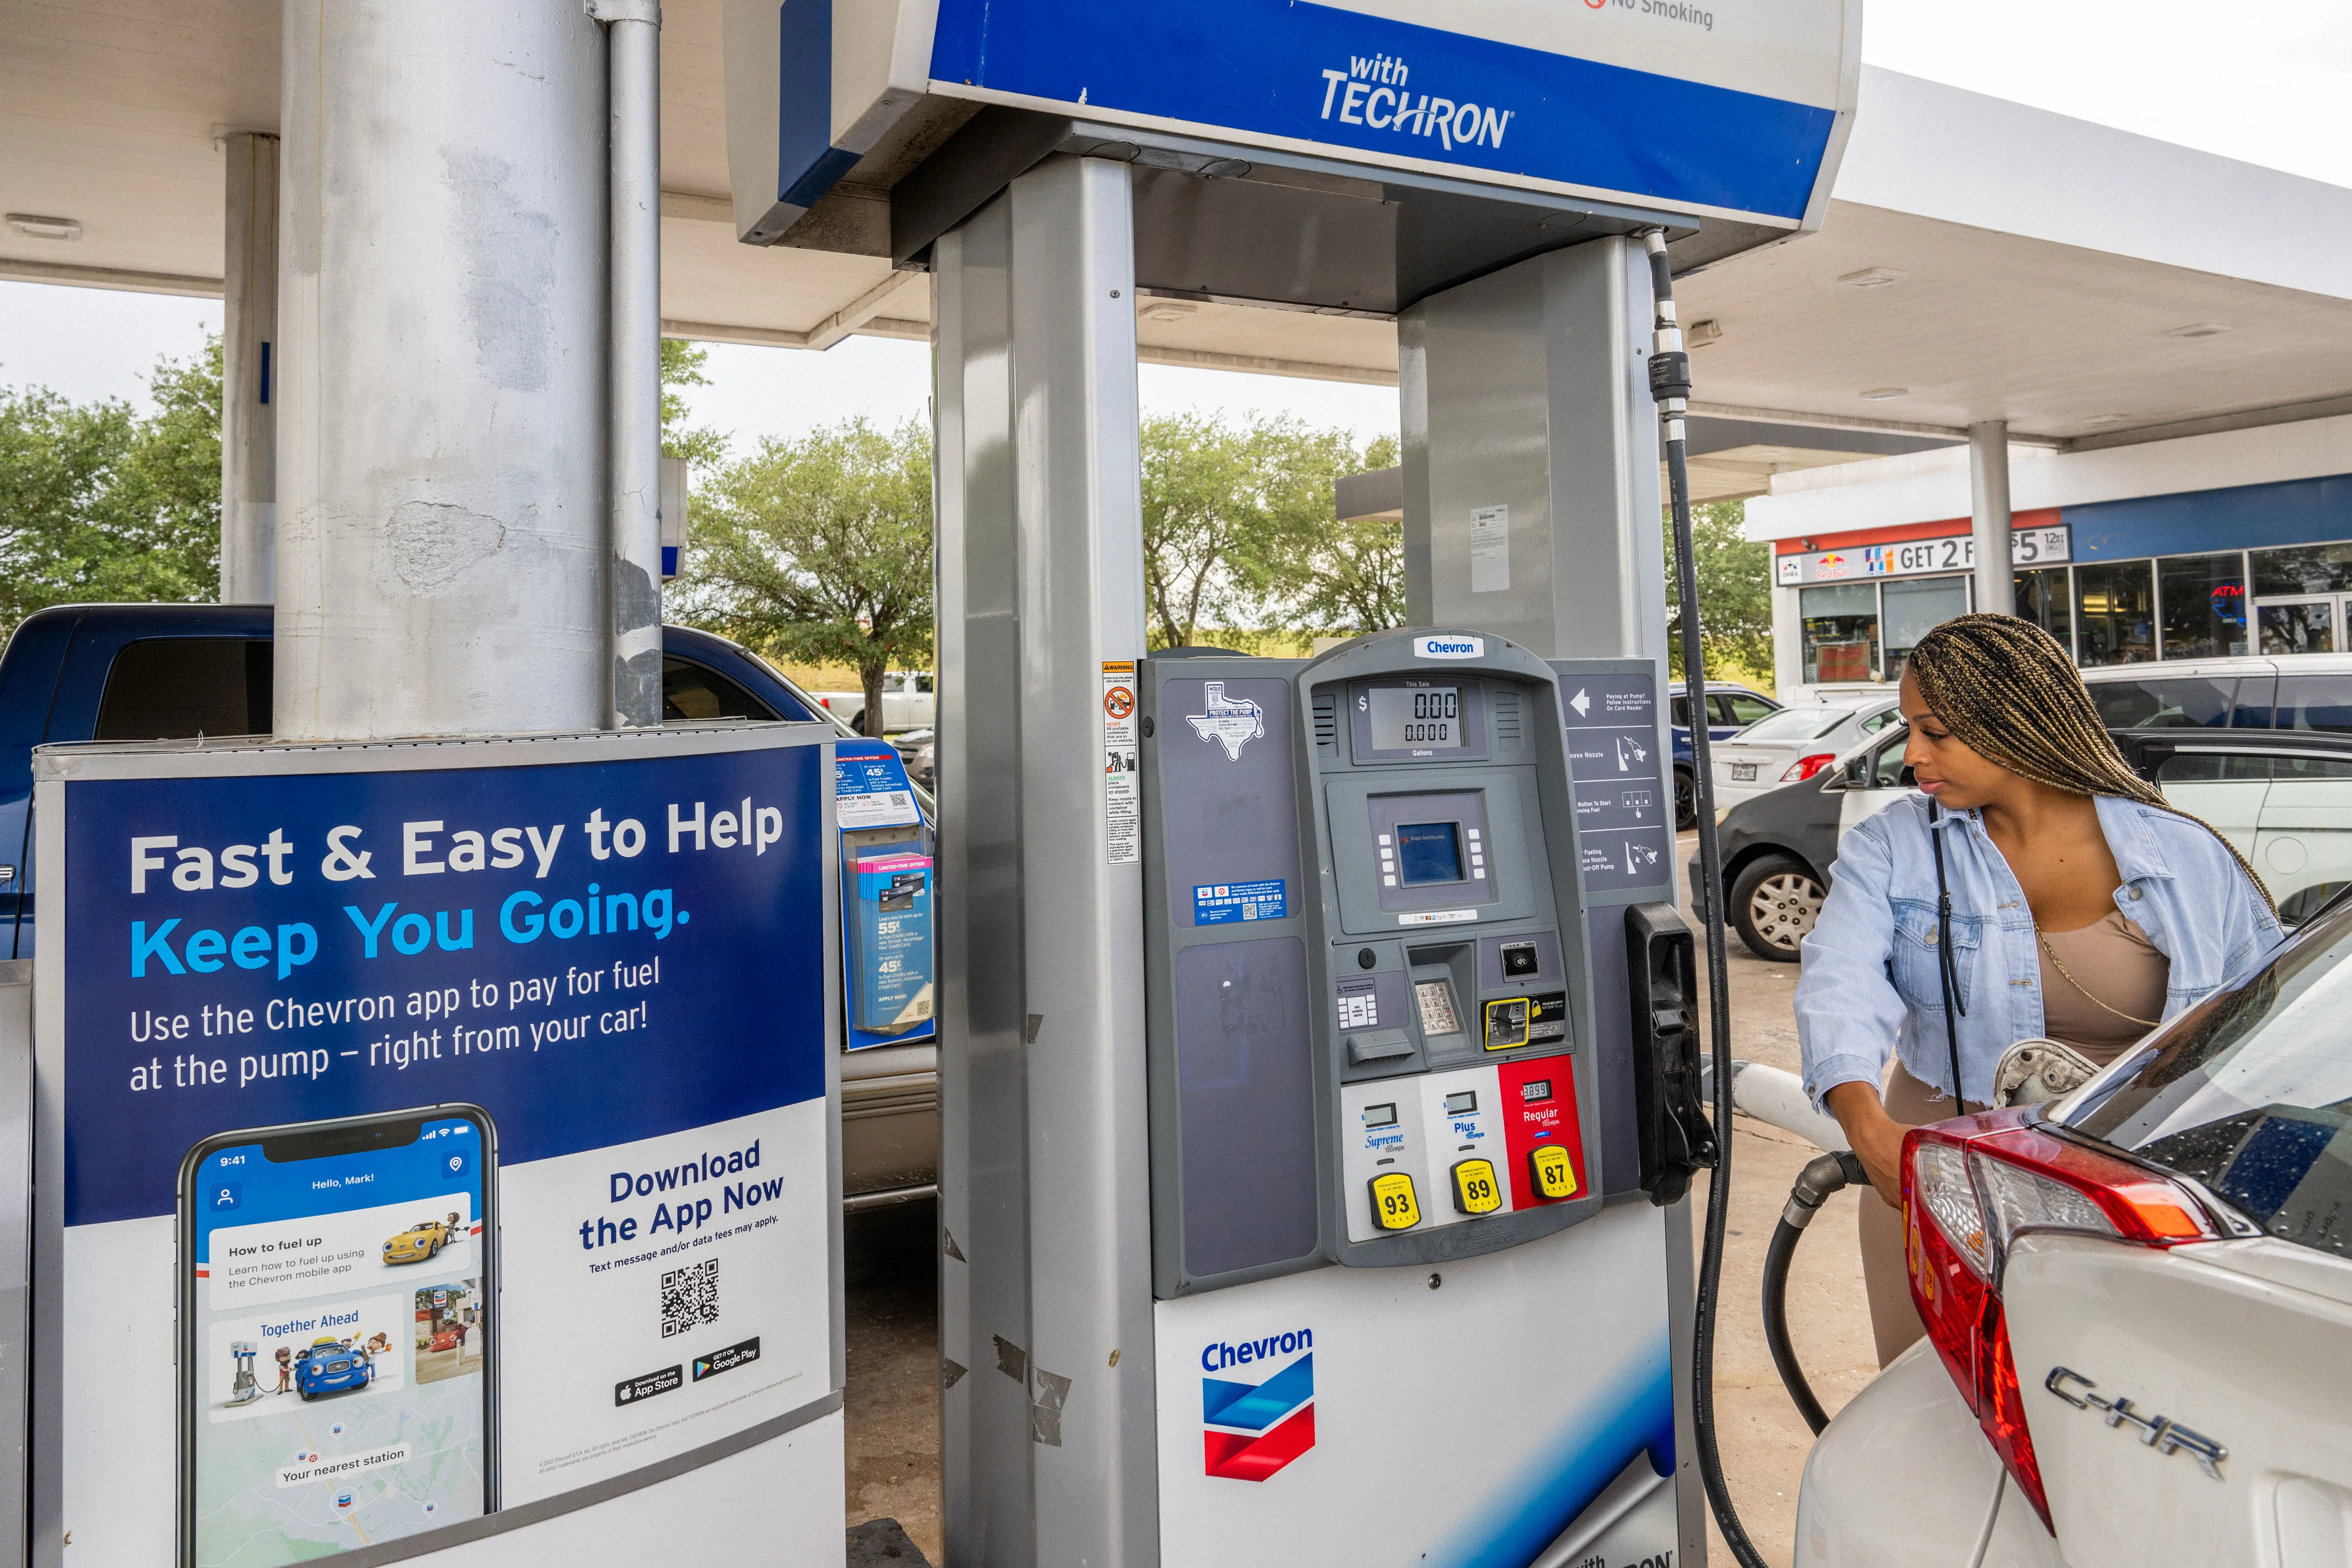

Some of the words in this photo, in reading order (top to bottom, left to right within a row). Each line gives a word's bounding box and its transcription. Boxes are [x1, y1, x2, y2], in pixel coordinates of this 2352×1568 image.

[1641, 0, 1713, 31] Smoking
[1351, 53, 1408, 87] with
[1901, 545, 1934, 569] GET
[1942, 540, 1958, 568] 2
[1833, 568, 1848, 577] Bull
[2211, 585, 2245, 597] ATM
[1427, 641, 1474, 653] Chevron
[1358, 696, 1367, 712] $
[1415, 693, 1456, 719] 0.00
[1405, 724, 1447, 741] 0.000
[132, 828, 293, 893] Fast
[321, 825, 376, 881] &
[403, 820, 565, 878] Easy
[584, 808, 646, 860] to
[668, 797, 783, 856] Help
[131, 918, 318, 981] Keep
[343, 902, 474, 958] You
[500, 883, 690, 944] Going.
[131, 1010, 189, 1042] Use
[201, 1004, 254, 1037] the
[267, 998, 395, 1030] Chevron
[407, 987, 459, 1021] app
[470, 979, 498, 1009] to
[510, 976, 557, 1010] pay
[567, 967, 604, 996] for
[613, 955, 659, 990] fuel
[130, 1057, 162, 1092] at
[174, 1054, 228, 1087] the
[240, 1048, 329, 1089] pump
[370, 1028, 442, 1071] right
[452, 1025, 520, 1056] from
[530, 1014, 591, 1051] your
[600, 1001, 647, 1034] car!
[1523, 1109, 1558, 1122] Regular
[1454, 1122, 1475, 1133] Plus
[1365, 1133, 1404, 1149] Supreme
[220, 1155, 246, 1167] 9:41
[610, 1138, 760, 1203] Download
[312, 1178, 341, 1190] Hello,
[345, 1173, 375, 1186] Mark!
[1545, 1165, 1564, 1184] 87
[1467, 1179, 1490, 1200] 89
[579, 1217, 637, 1250] the
[649, 1198, 712, 1235] App
[724, 1177, 784, 1214] Now
[1385, 1194, 1410, 1215] 93
[229, 1246, 257, 1257] How
[261, 1244, 274, 1253] to
[278, 1238, 302, 1250] fuel
[307, 1238, 323, 1247] up
[589, 1261, 611, 1274] Text
[615, 1250, 657, 1268] message
[661, 1241, 690, 1256] and/or
[693, 1235, 712, 1247] data
[715, 1230, 732, 1241] fees
[735, 1224, 753, 1235] may
[755, 1215, 778, 1228] apply.
[229, 1266, 258, 1276] Learn
[261, 1262, 282, 1271] how
[285, 1259, 296, 1267] to
[300, 1255, 318, 1265] fuel
[321, 1255, 334, 1263] up
[337, 1250, 364, 1260] using
[229, 1280, 246, 1288] the
[249, 1274, 293, 1286] Chevron
[295, 1267, 330, 1279] mobile
[333, 1264, 352, 1274] app
[261, 1320, 316, 1337] Together
[320, 1310, 359, 1327] Ahead
[713, 1356, 740, 1370] Google
[741, 1349, 757, 1361] Play
[1202, 1329, 1312, 1372] Chevron
[635, 1376, 659, 1387] Download
[635, 1384, 653, 1397] App
[655, 1377, 678, 1391] Store
[2045, 1366, 2228, 1482] C-HR
[283, 1469, 310, 1482] Your
[314, 1458, 360, 1477] nearest
[363, 1449, 404, 1467] station
